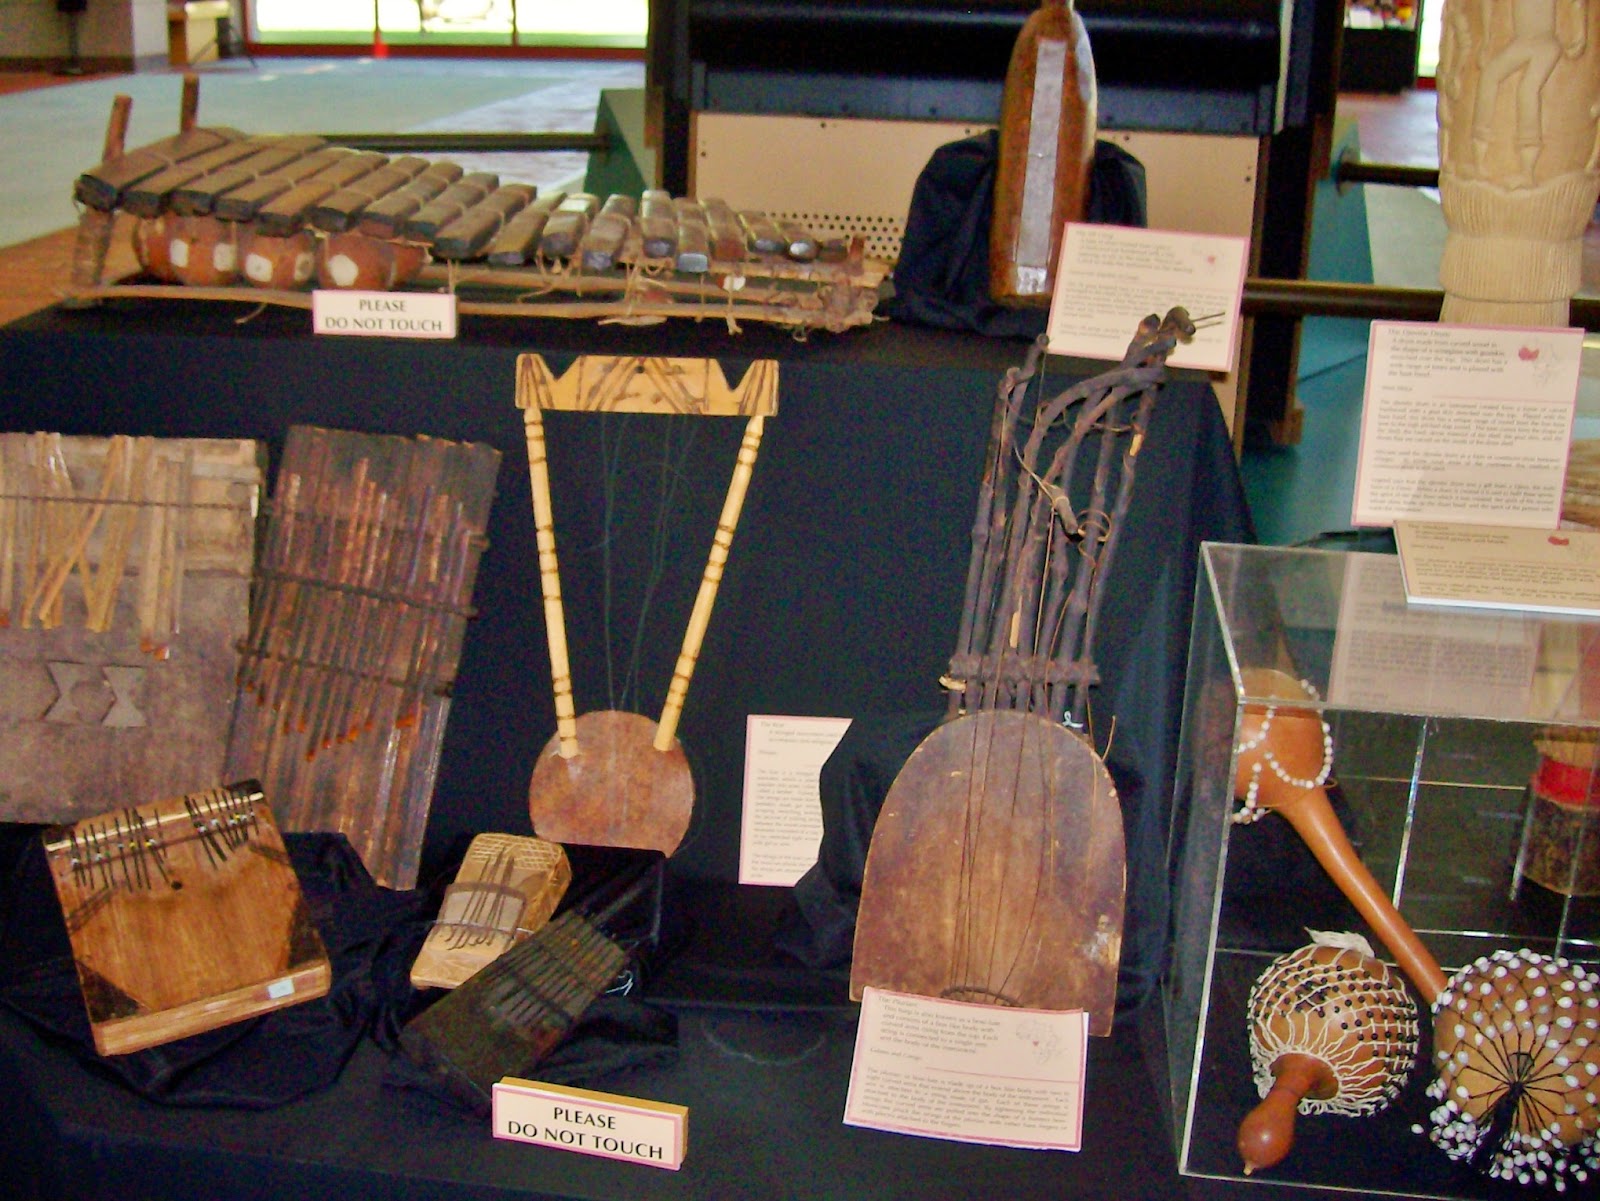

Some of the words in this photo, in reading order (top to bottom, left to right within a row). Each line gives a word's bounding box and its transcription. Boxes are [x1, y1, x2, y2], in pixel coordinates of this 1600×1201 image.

[359, 299, 407, 312] PLEASE
[325, 317, 348, 329] DO
[352, 317, 383, 330] NOT
[390, 319, 442, 331] TOUCH
[554, 1107, 616, 1130] PLEASE
[508, 1121, 538, 1138] DO
[544, 1128, 586, 1146] NOT
[592, 1135, 663, 1159] TOUCH
